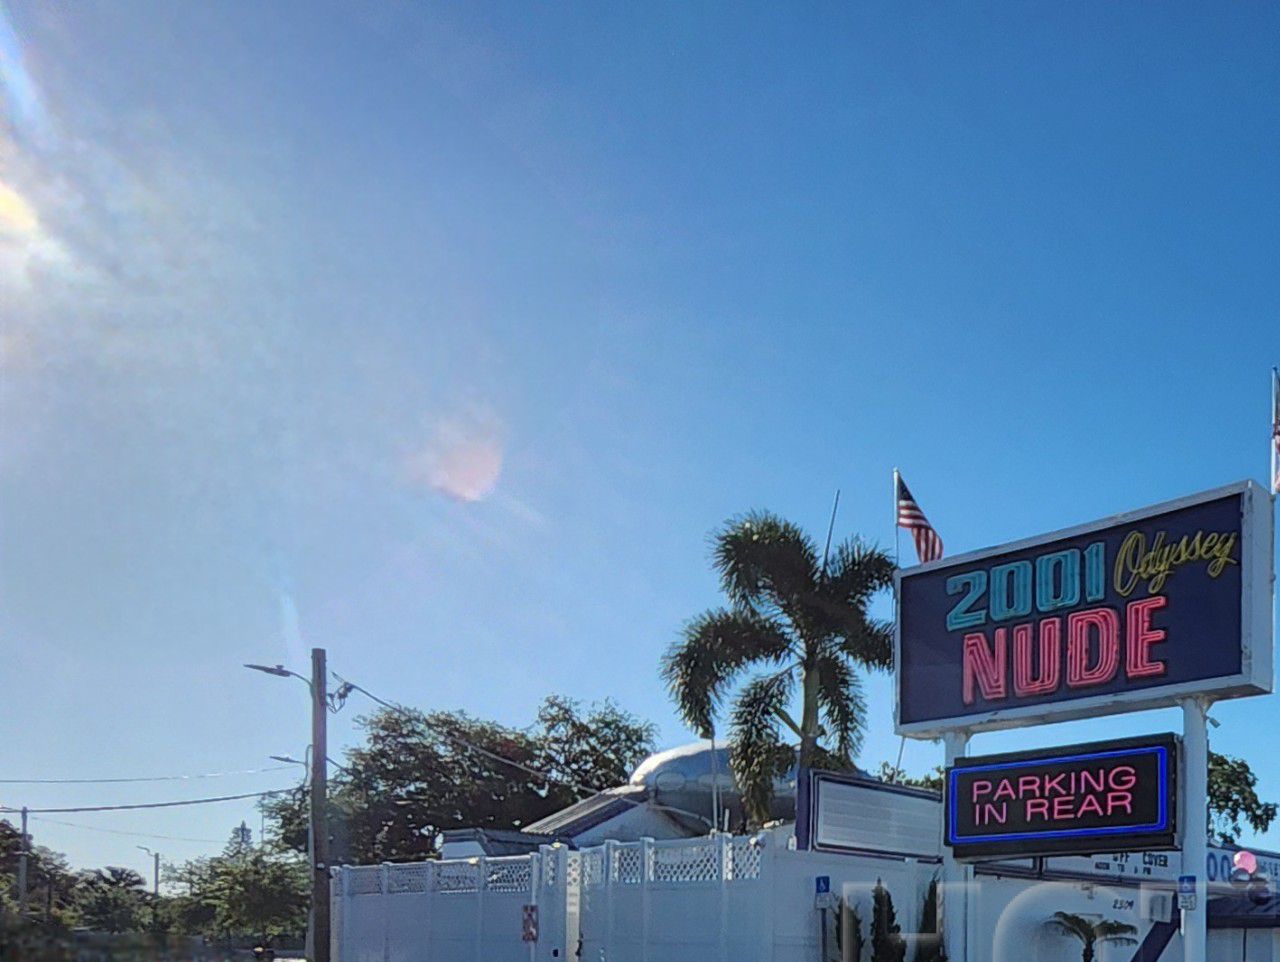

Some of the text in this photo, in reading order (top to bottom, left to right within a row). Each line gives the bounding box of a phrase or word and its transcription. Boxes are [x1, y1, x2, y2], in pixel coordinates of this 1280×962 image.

[946, 530, 1238, 631] 2001 Odyssey
[962, 595, 1168, 705] NUDE
[972, 765, 1136, 804] PARKING
[975, 791, 1133, 826] IN REAR
[1142, 851, 1168, 868] COVER
